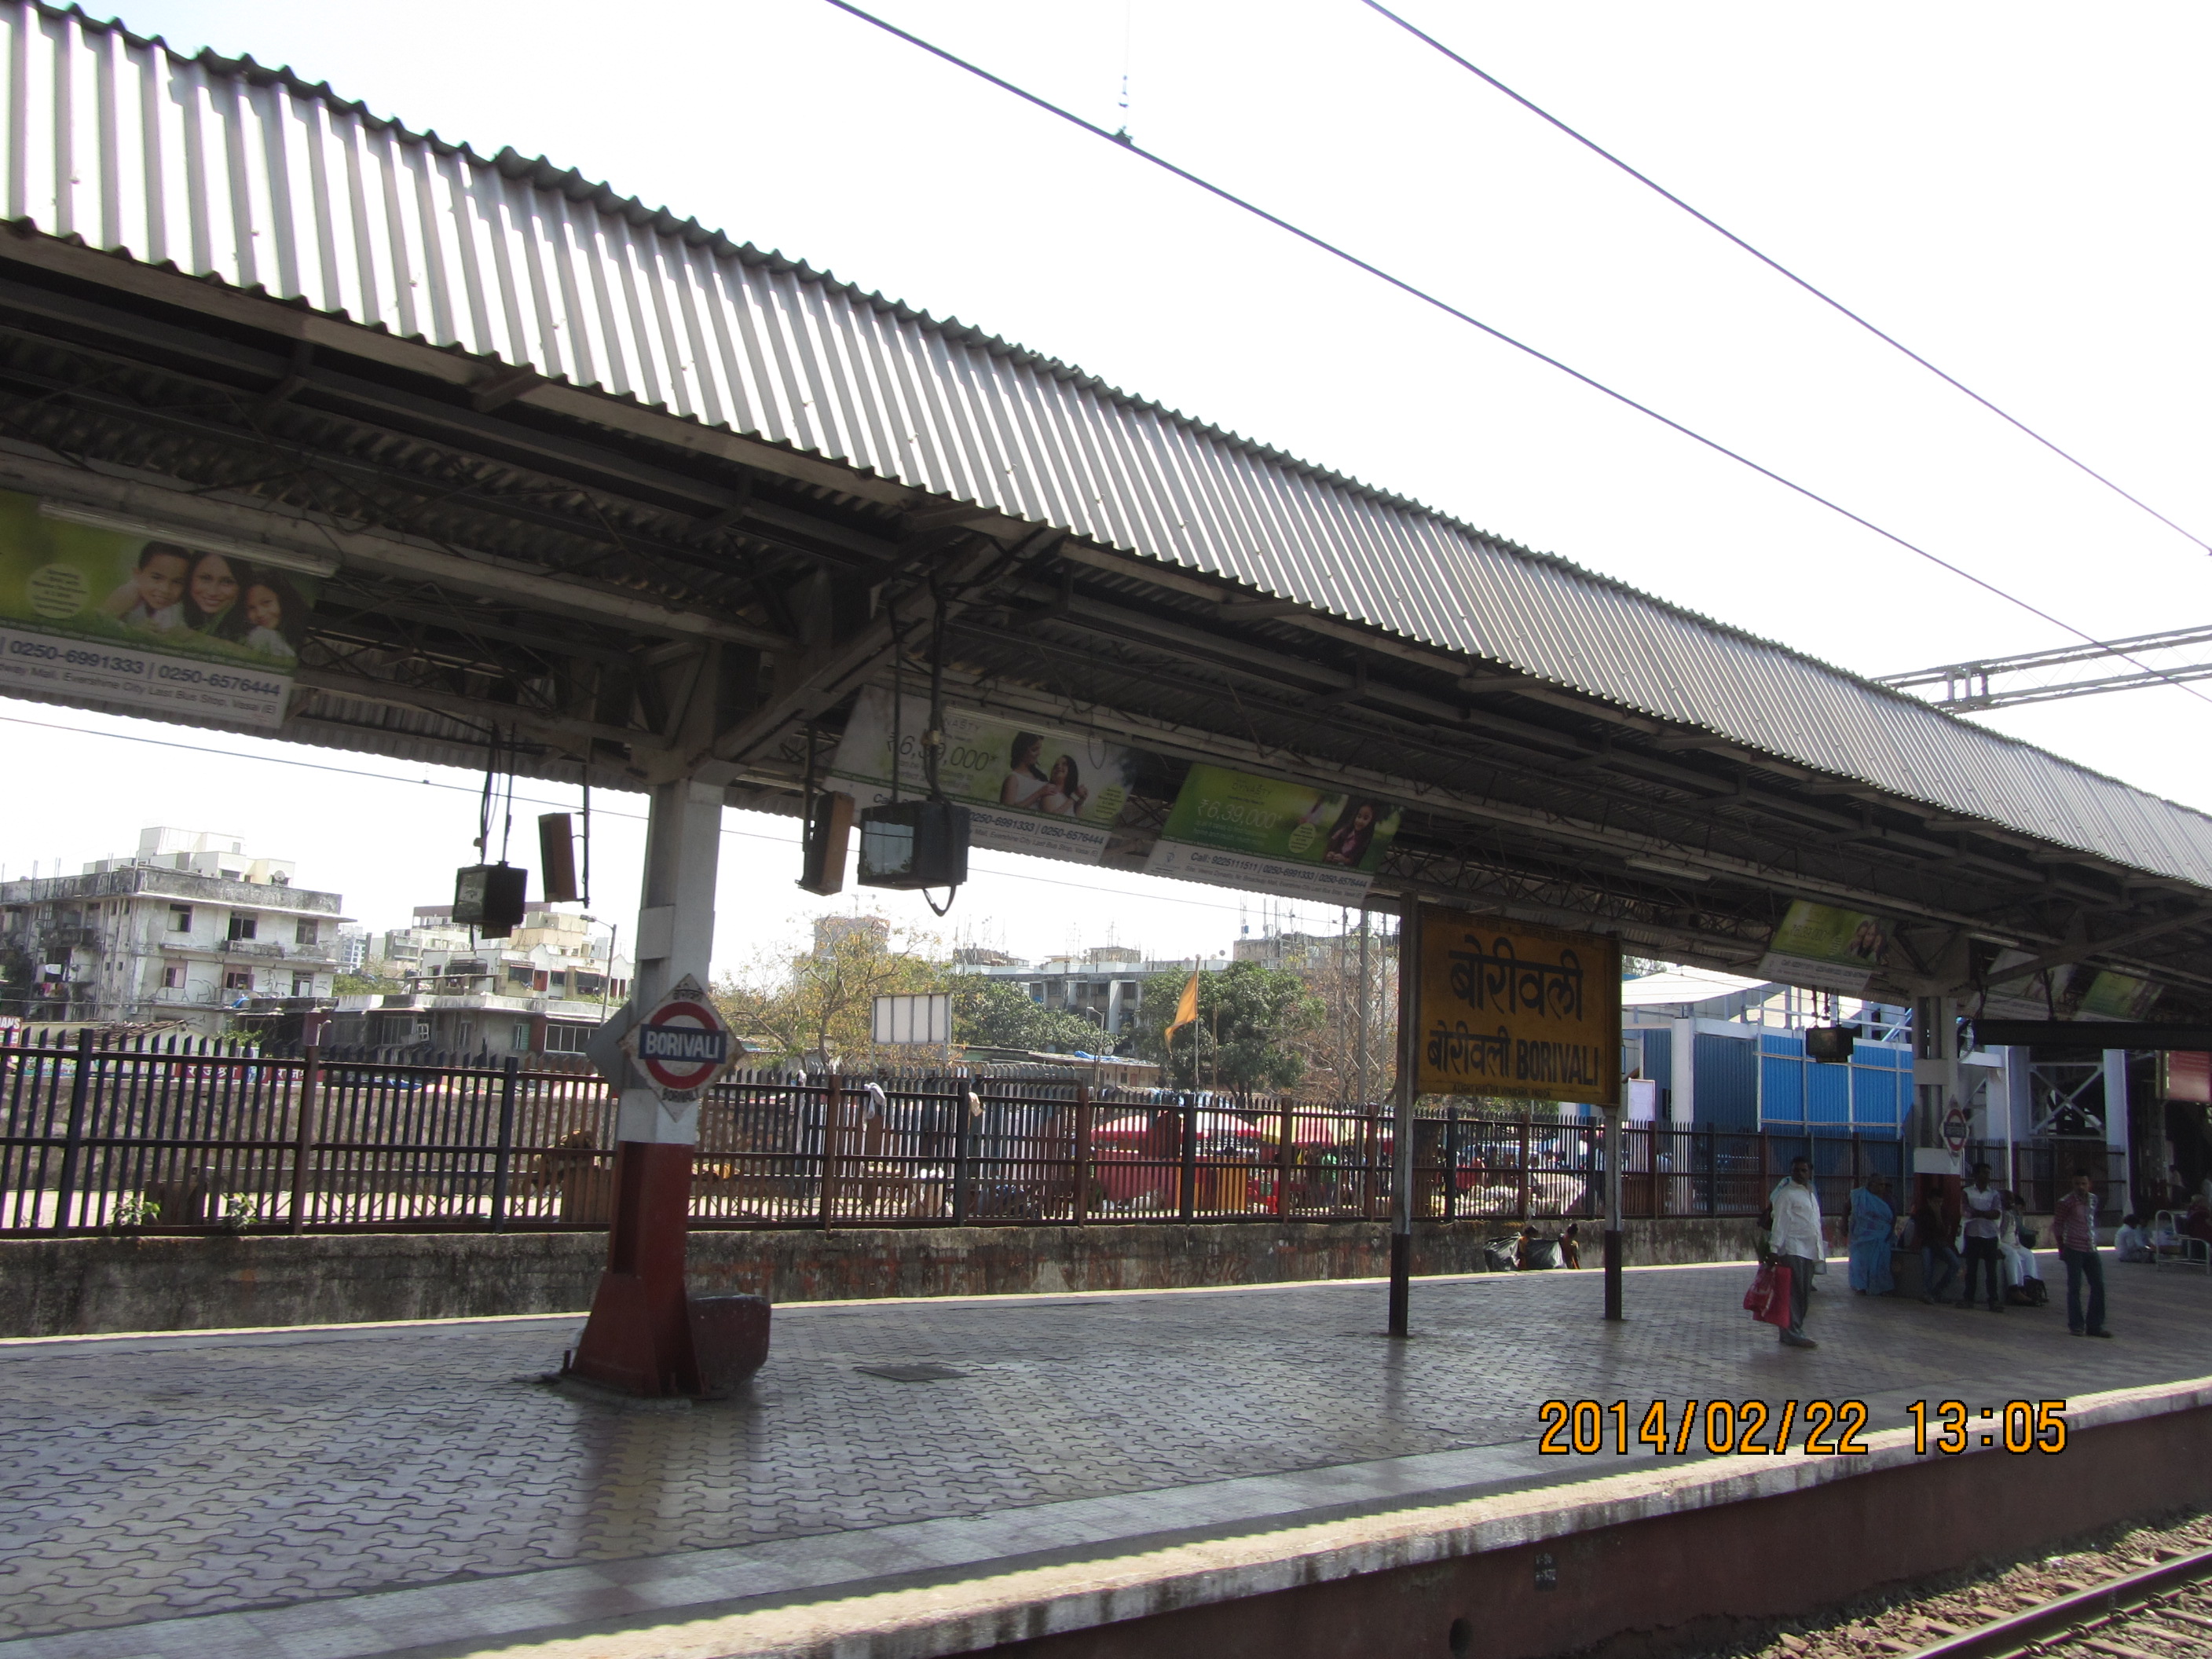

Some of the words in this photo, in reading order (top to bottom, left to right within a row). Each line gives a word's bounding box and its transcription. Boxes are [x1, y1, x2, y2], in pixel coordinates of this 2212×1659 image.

[10, 640, 145, 674] 0250-6991333
[159, 665, 280, 696] 0250-6576444
[123, 682, 145, 695] City
[149, 686, 172, 698] Last
[176, 690, 196, 701] Bus
[1040, 826, 1104, 844] 0250-6576444
[1191, 852, 1211, 862] Call:
[1211, 855, 1257, 870] 9225111511
[1263, 865, 1314, 880] 0250-6991333
[1448, 934, 1584, 1022] बोरीवली
[645, 1031, 720, 1059] BORIVALI
[1516, 1038, 1599, 1086] BORIVALI
